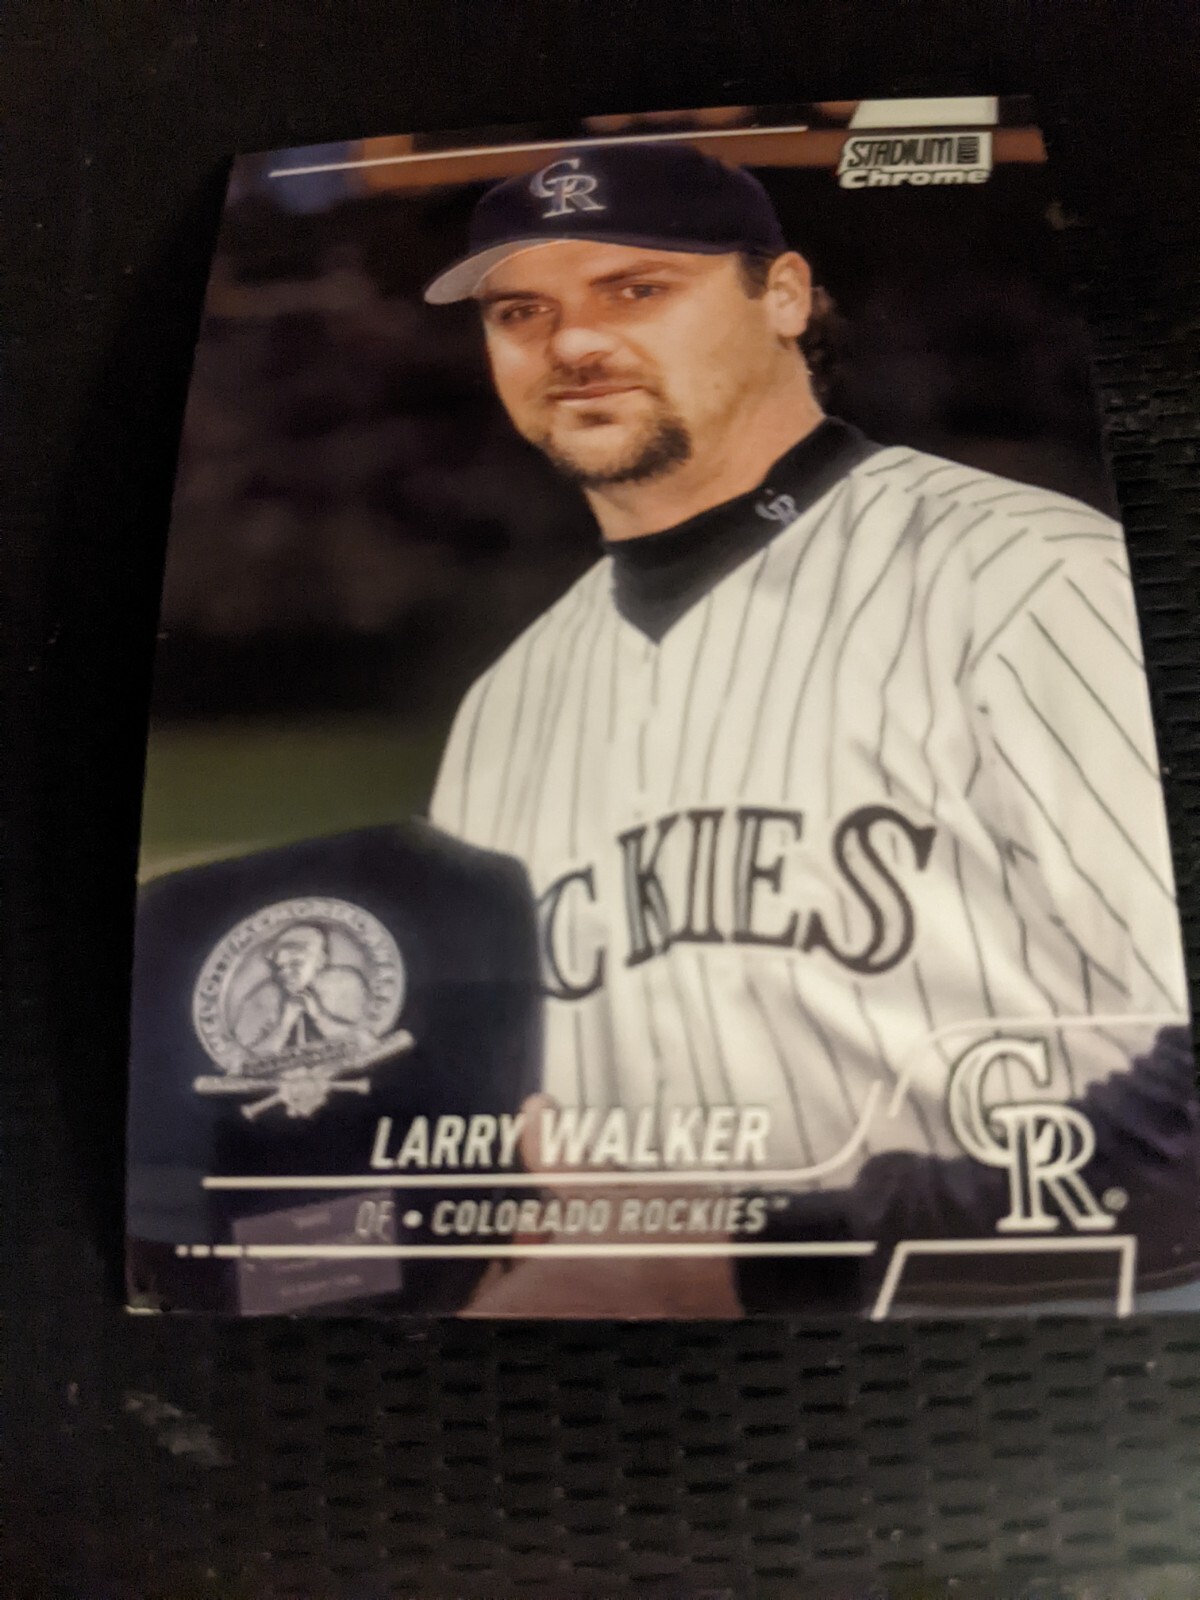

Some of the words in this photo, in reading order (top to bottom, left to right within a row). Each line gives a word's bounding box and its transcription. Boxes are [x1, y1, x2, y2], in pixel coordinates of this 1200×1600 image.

[847, 137, 953, 168] STADIUM
[839, 168, 990, 189] Chrome
[370, 1113, 526, 1170] LARRY
[538, 1106, 770, 1168] WALKER
[355, 1200, 396, 1238] OF
[430, 1199, 611, 1236] COLORADO
